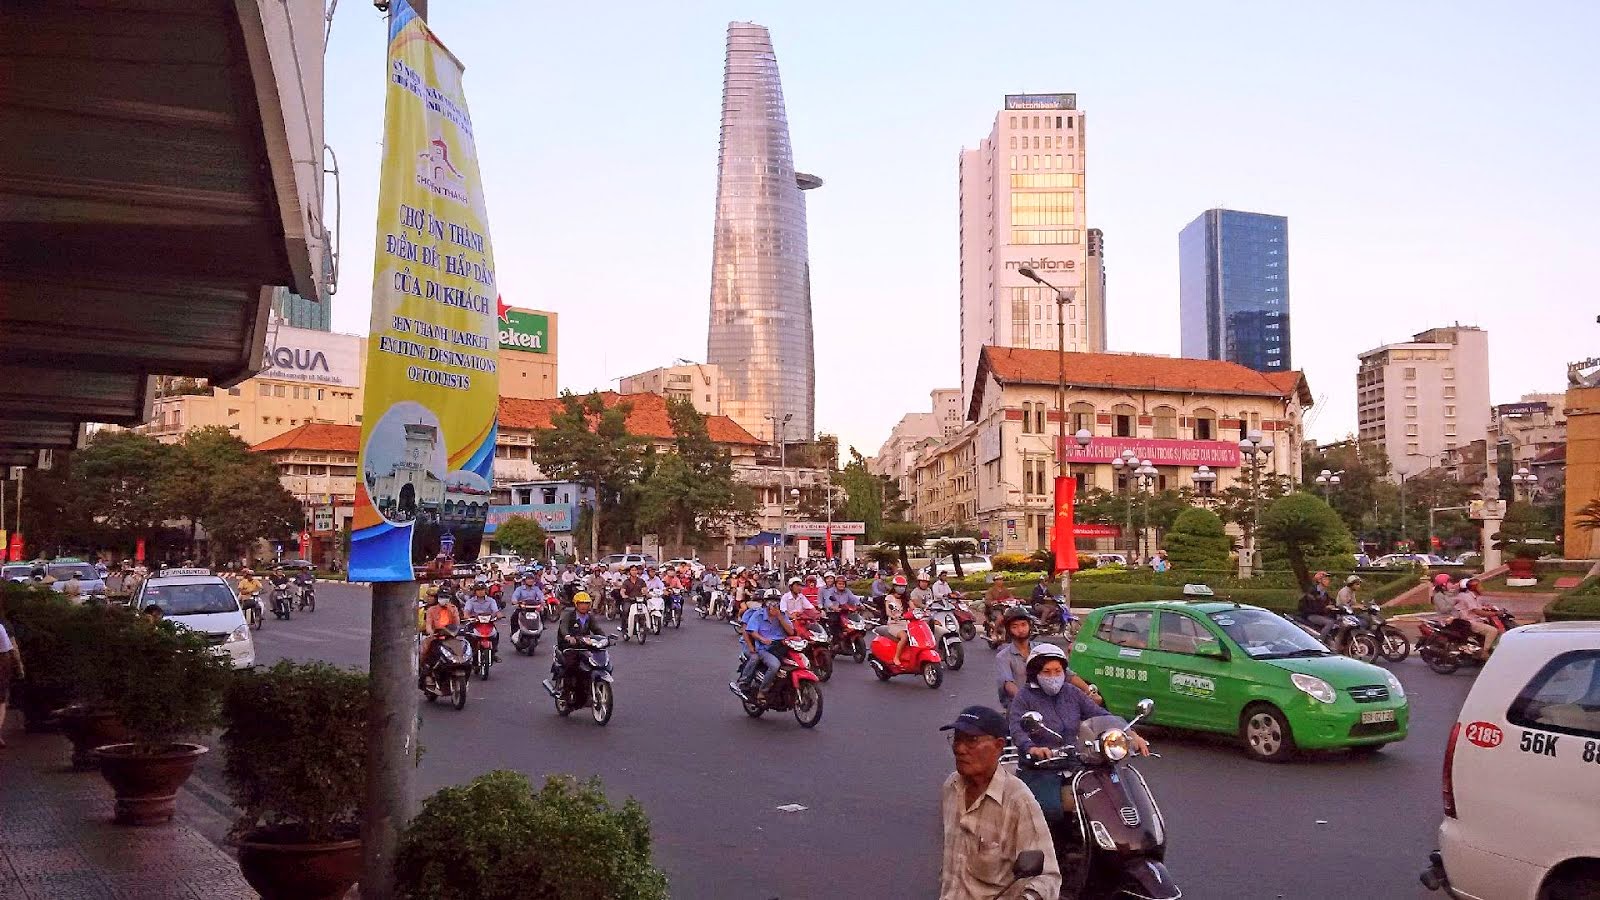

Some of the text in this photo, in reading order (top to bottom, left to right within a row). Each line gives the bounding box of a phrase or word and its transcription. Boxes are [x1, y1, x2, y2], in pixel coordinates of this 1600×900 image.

[428, 211, 445, 241] BN
[448, 222, 485, 254] THÀNH
[445, 252, 471, 277] HẤP
[1005, 256, 1076, 270] mobifone
[394, 266, 421, 296] CỦA
[443, 286, 490, 315] KHÁCH
[414, 319, 449, 341] THANH
[498, 327, 542, 348] eken
[1104, 665, 1115, 677] 38
[1115, 667, 1125, 679] 38
[1126, 668, 1136, 680] 38
[1137, 670, 1148, 682] 38
[1468, 724, 1501, 745] 2185
[1519, 730, 1560, 757] 56K
